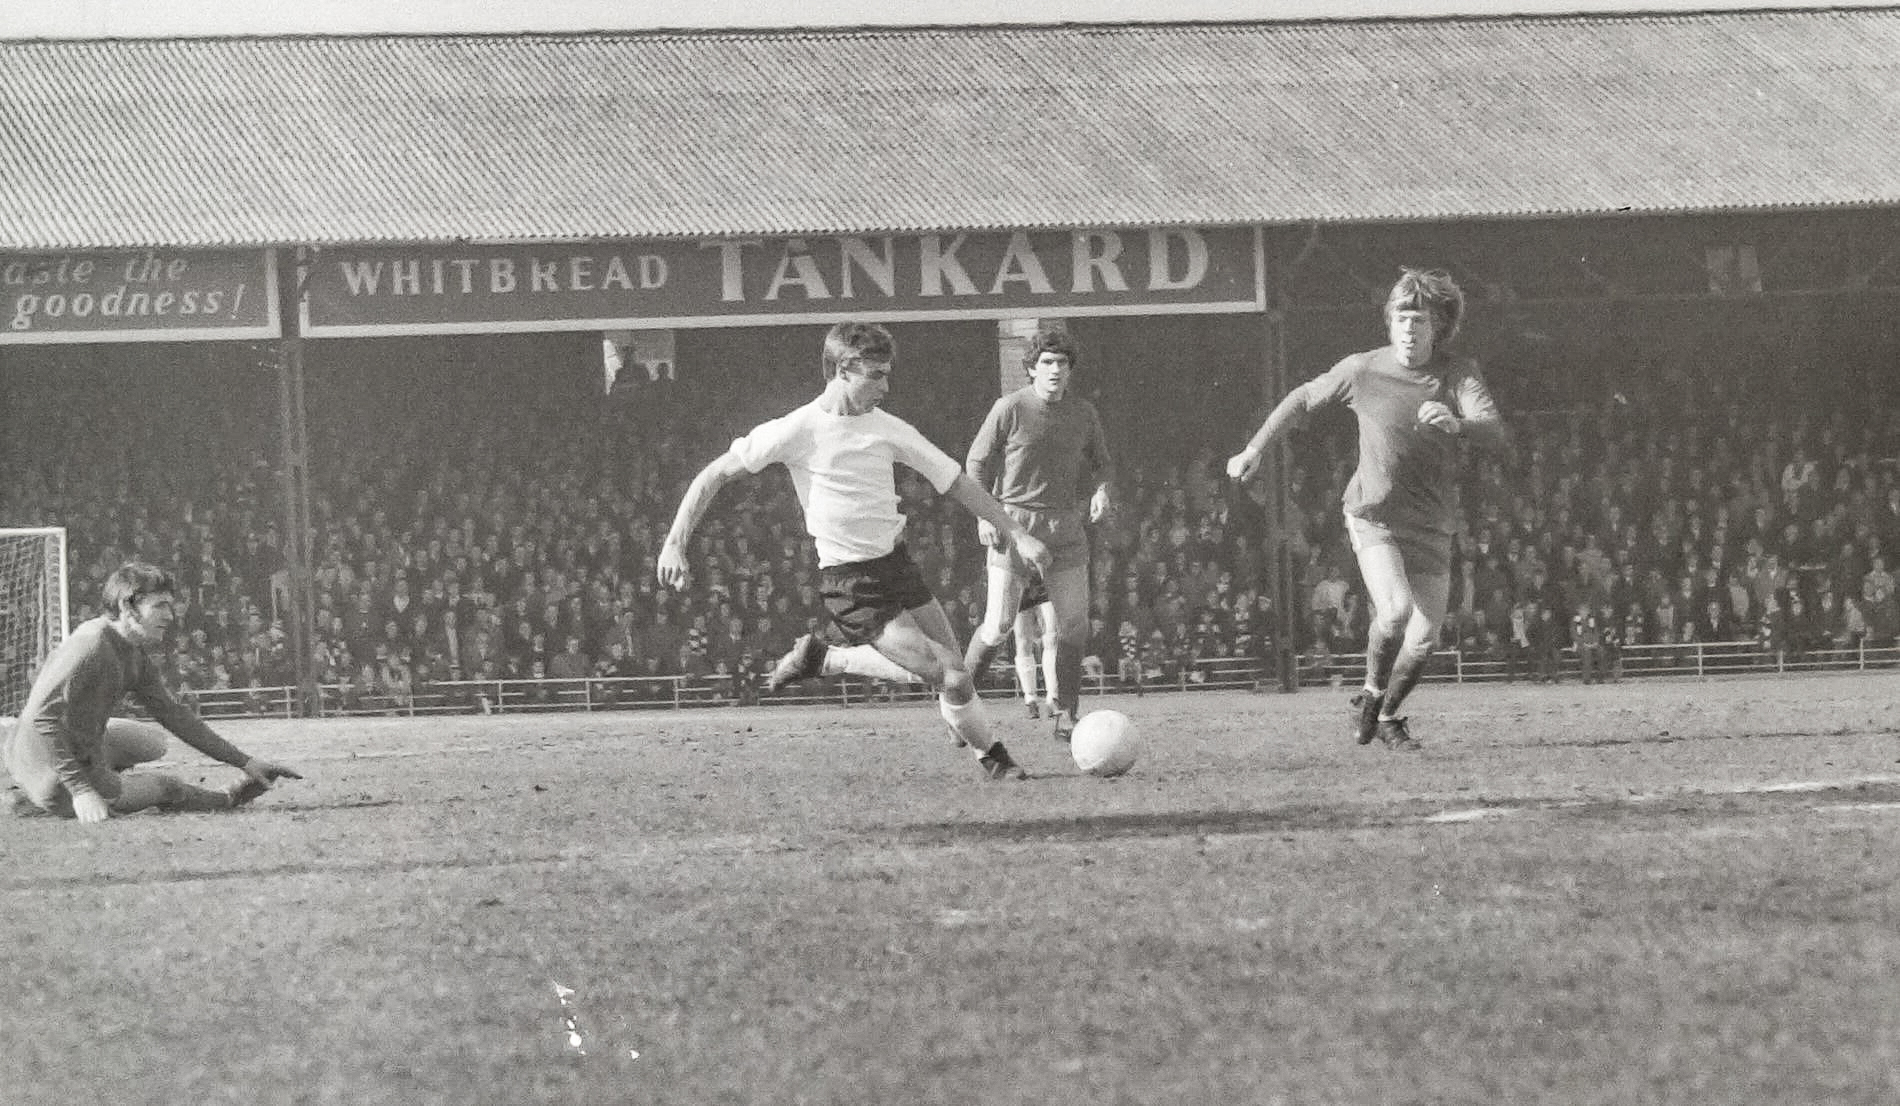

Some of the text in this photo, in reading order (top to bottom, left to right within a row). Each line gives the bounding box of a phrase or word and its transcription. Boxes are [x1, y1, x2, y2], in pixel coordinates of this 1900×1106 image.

[125, 250, 188, 283] the
[341, 228, 1209, 302] WHITBREAD TANKARD
[9, 284, 245, 330] goodness!
